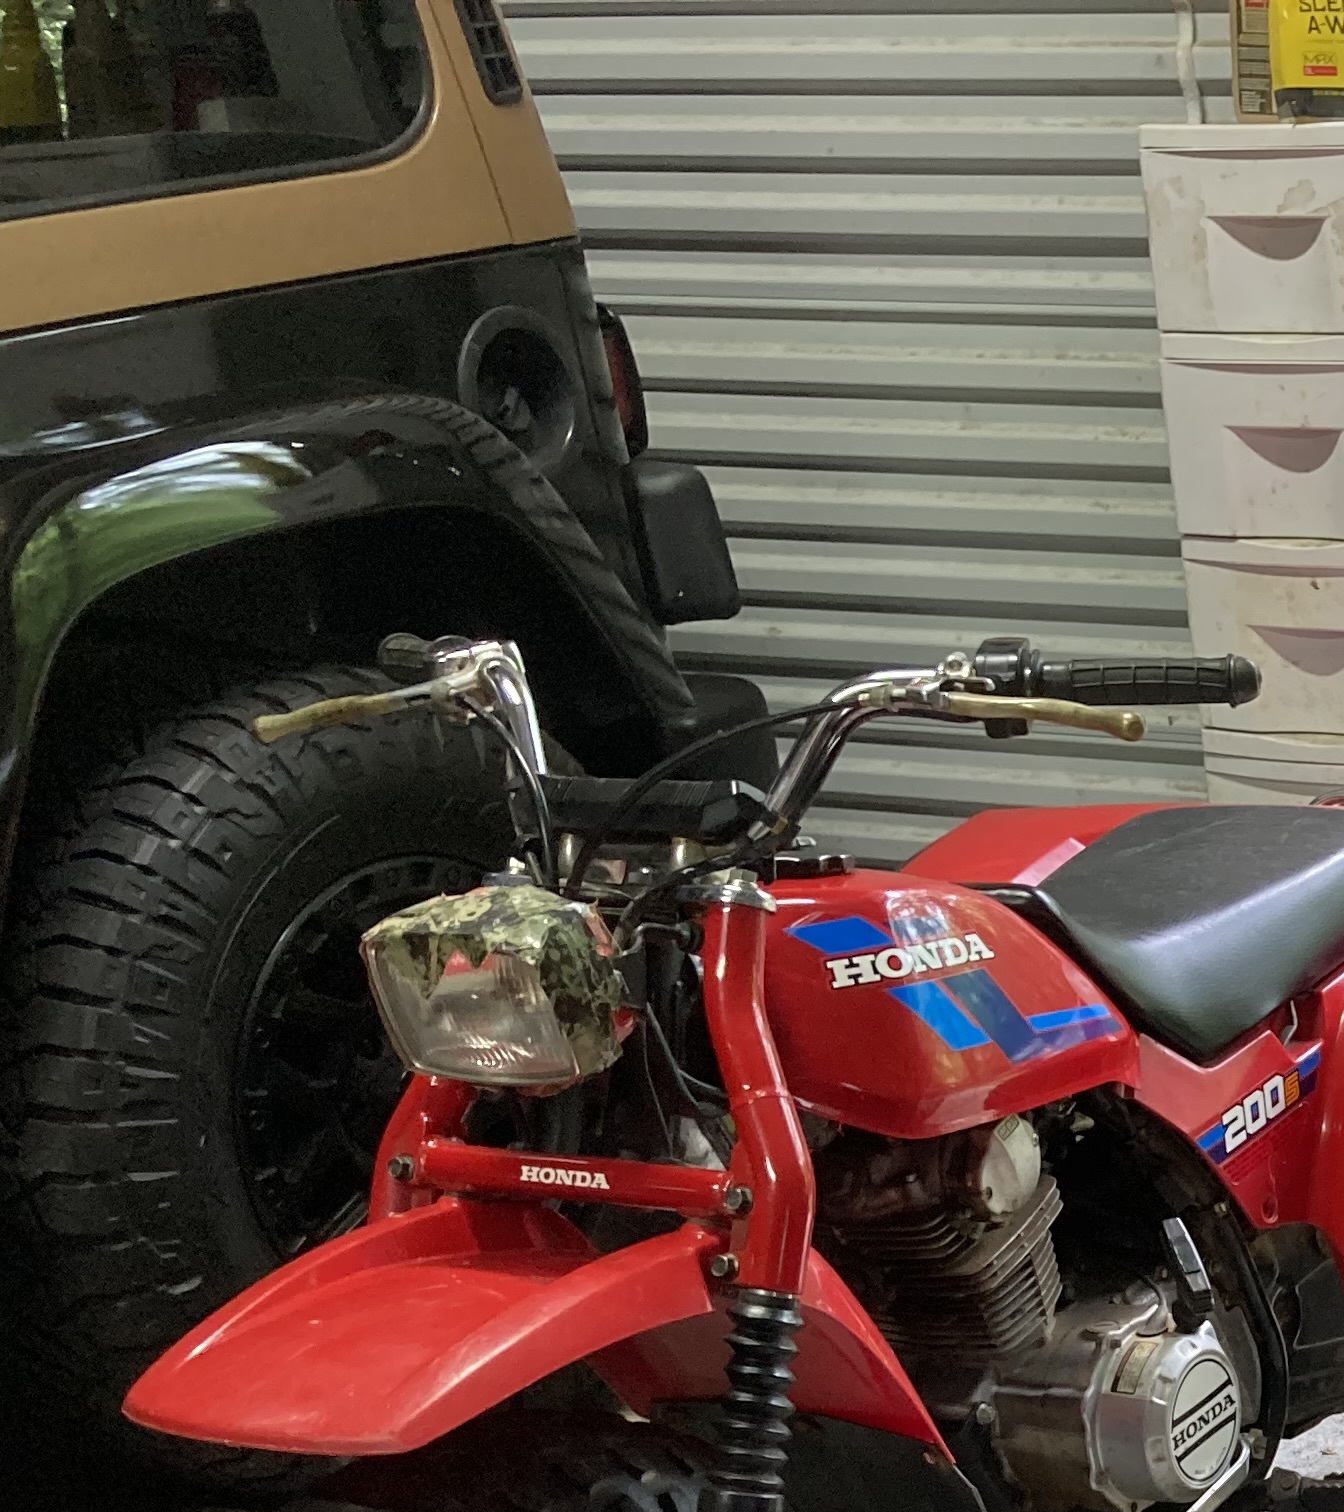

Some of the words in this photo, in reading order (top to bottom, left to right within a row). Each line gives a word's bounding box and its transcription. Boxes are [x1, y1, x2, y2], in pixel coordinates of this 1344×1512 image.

[826, 933, 996, 989] HONDA
[520, 1165, 610, 1190] HONDA
[1171, 1394, 1236, 1451] HONDA
